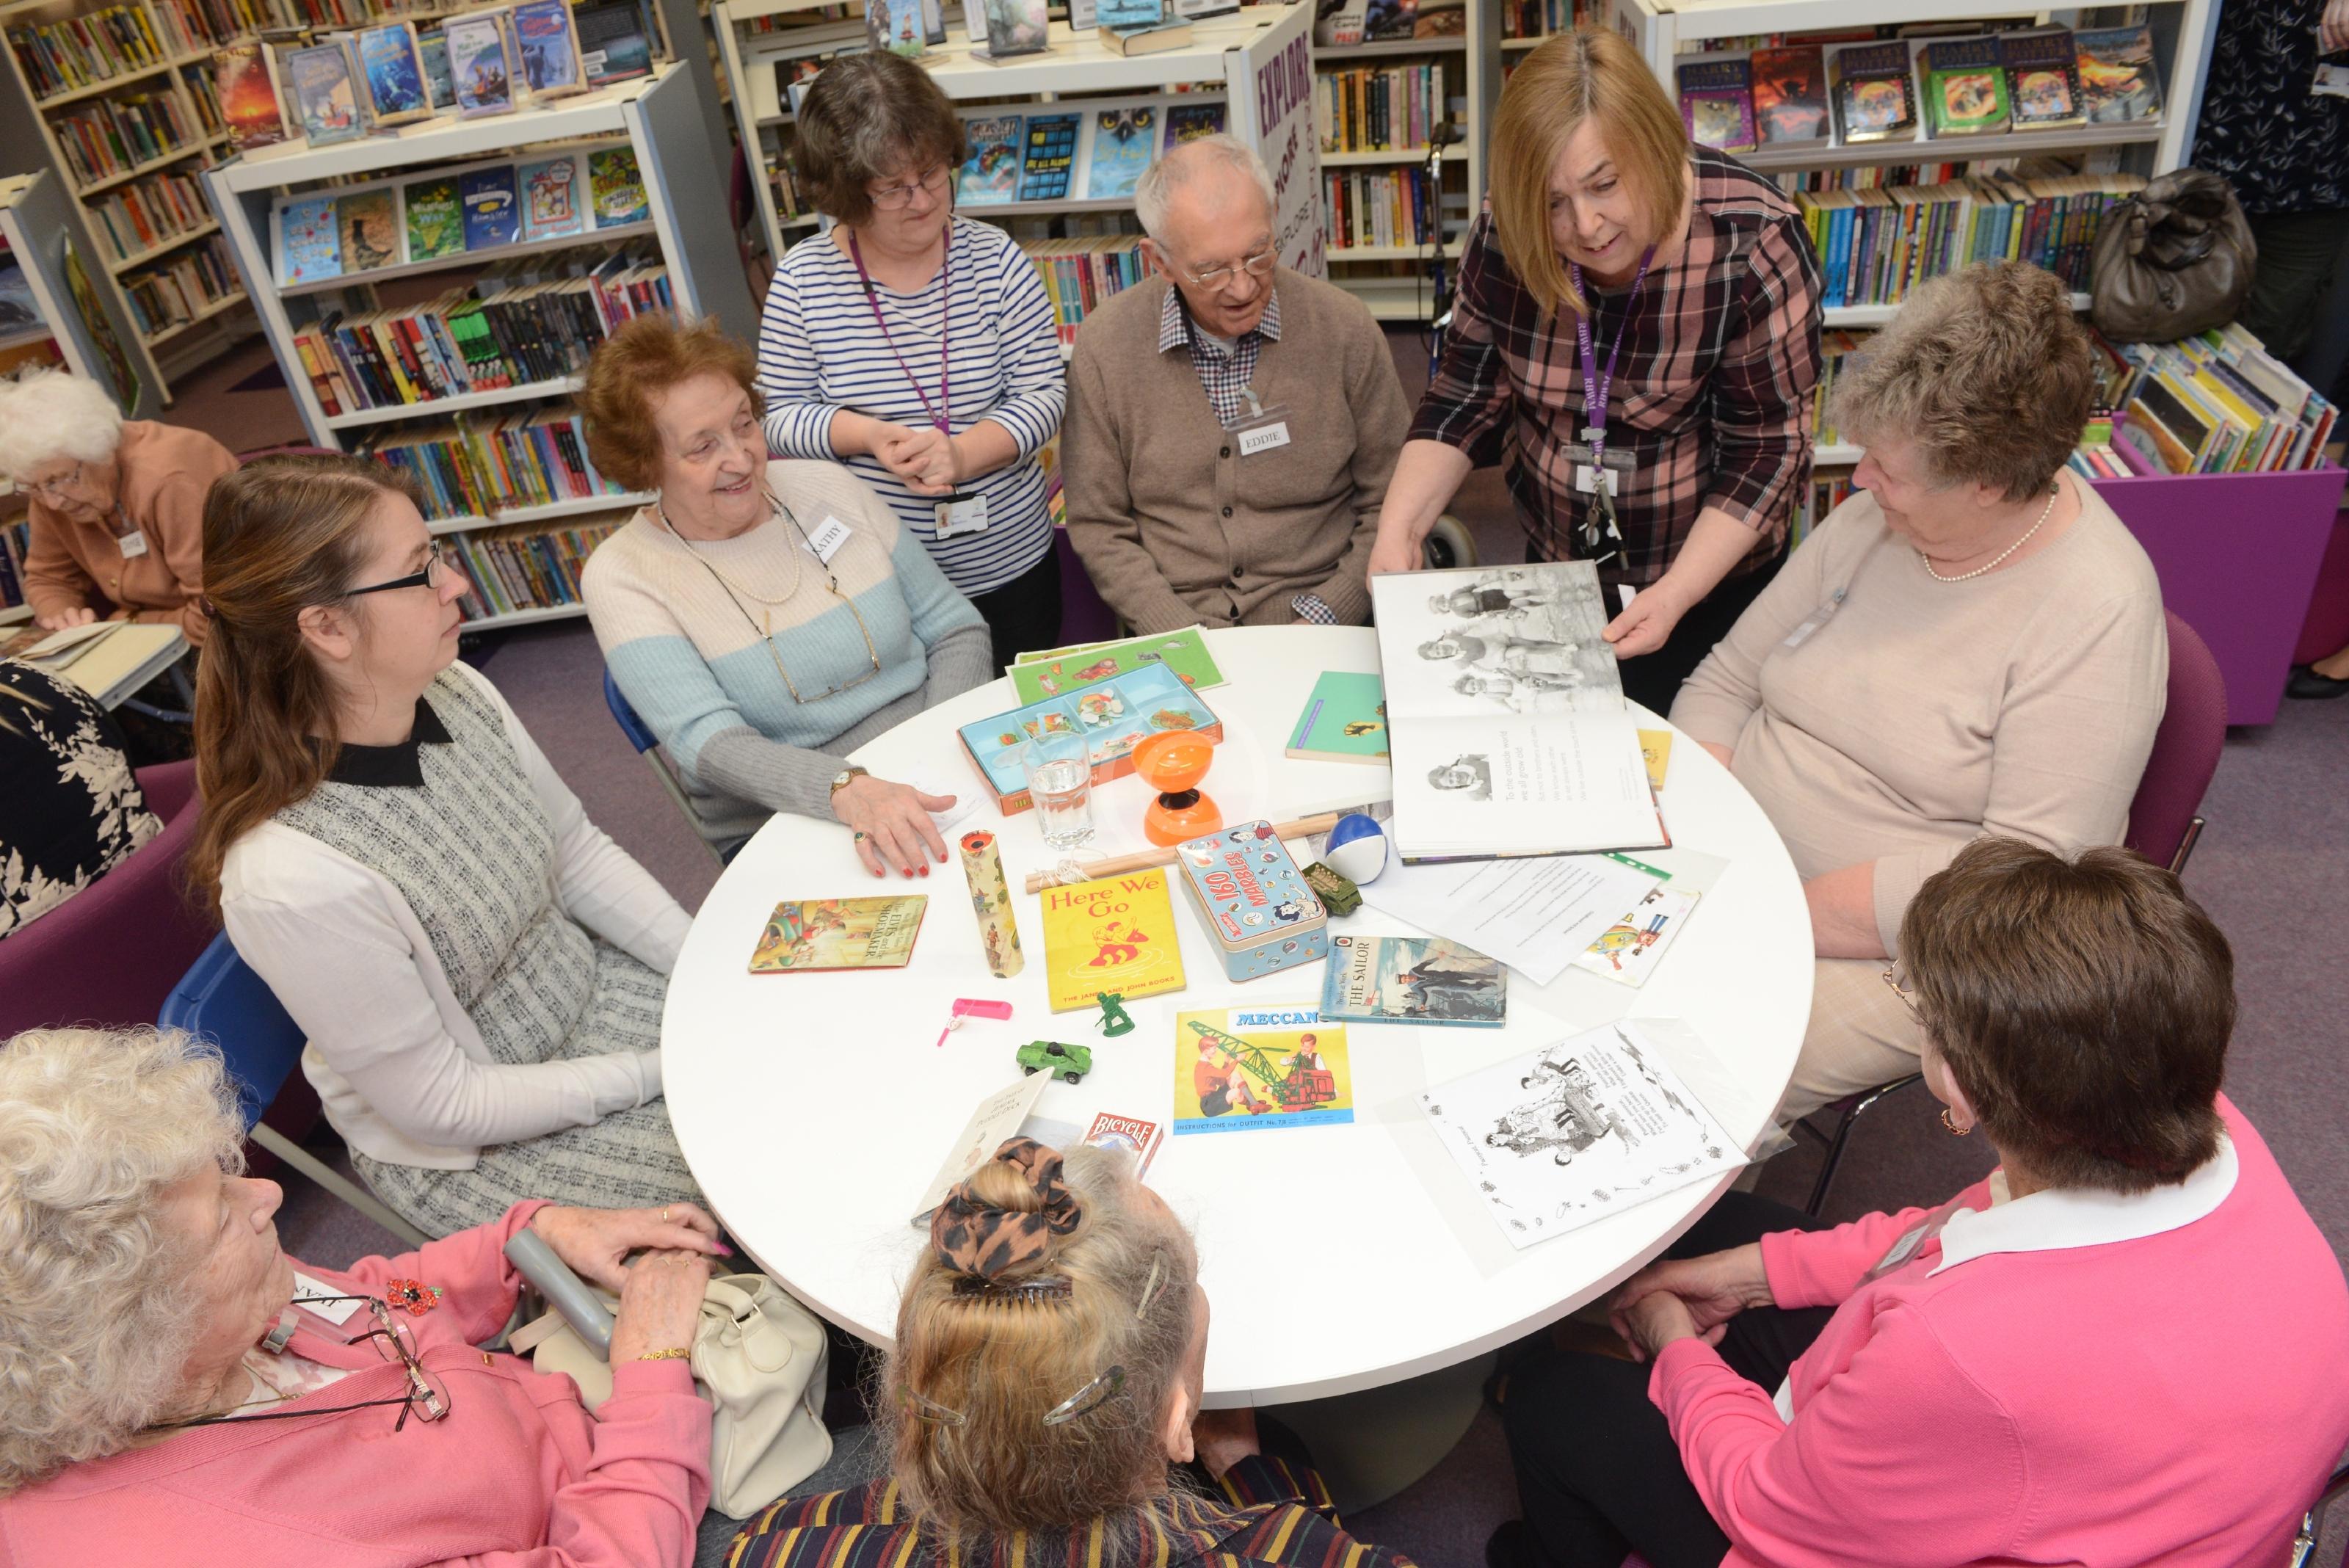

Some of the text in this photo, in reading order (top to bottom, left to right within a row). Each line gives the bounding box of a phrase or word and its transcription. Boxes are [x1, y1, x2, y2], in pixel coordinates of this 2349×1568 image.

[1258, 30, 1311, 139] EXPLORE
[1578, 322, 1591, 356] RBWM
[1584, 377, 1597, 410] RBWM
[1597, 375, 1611, 409] RBWM
[1246, 432, 1281, 448] EDDIE
[1499, 730, 1509, 749] world
[1502, 751, 1512, 776] outside
[1517, 761, 1528, 779] grow
[1504, 777, 1514, 790] the
[1203, 870, 1241, 901] 160
[1223, 850, 1270, 907] MARBLES
[1050, 876, 1160, 911] Here We
[1088, 900, 1130, 918] Go
[865, 904, 893, 957] SHOEMAKER
[885, 914, 902, 937] ELVES
[1107, 987, 1124, 995] AND
[1127, 982, 1147, 992] JOHN
[1149, 976, 1175, 987] BOOKS
[1349, 942, 1370, 1006] THE SAILOR
[1236, 1009, 1326, 1026] MECCAN
[1090, 1115, 1152, 1148] BICYCLE
[1177, 1122, 1226, 1130] INSTRUCTIONS
